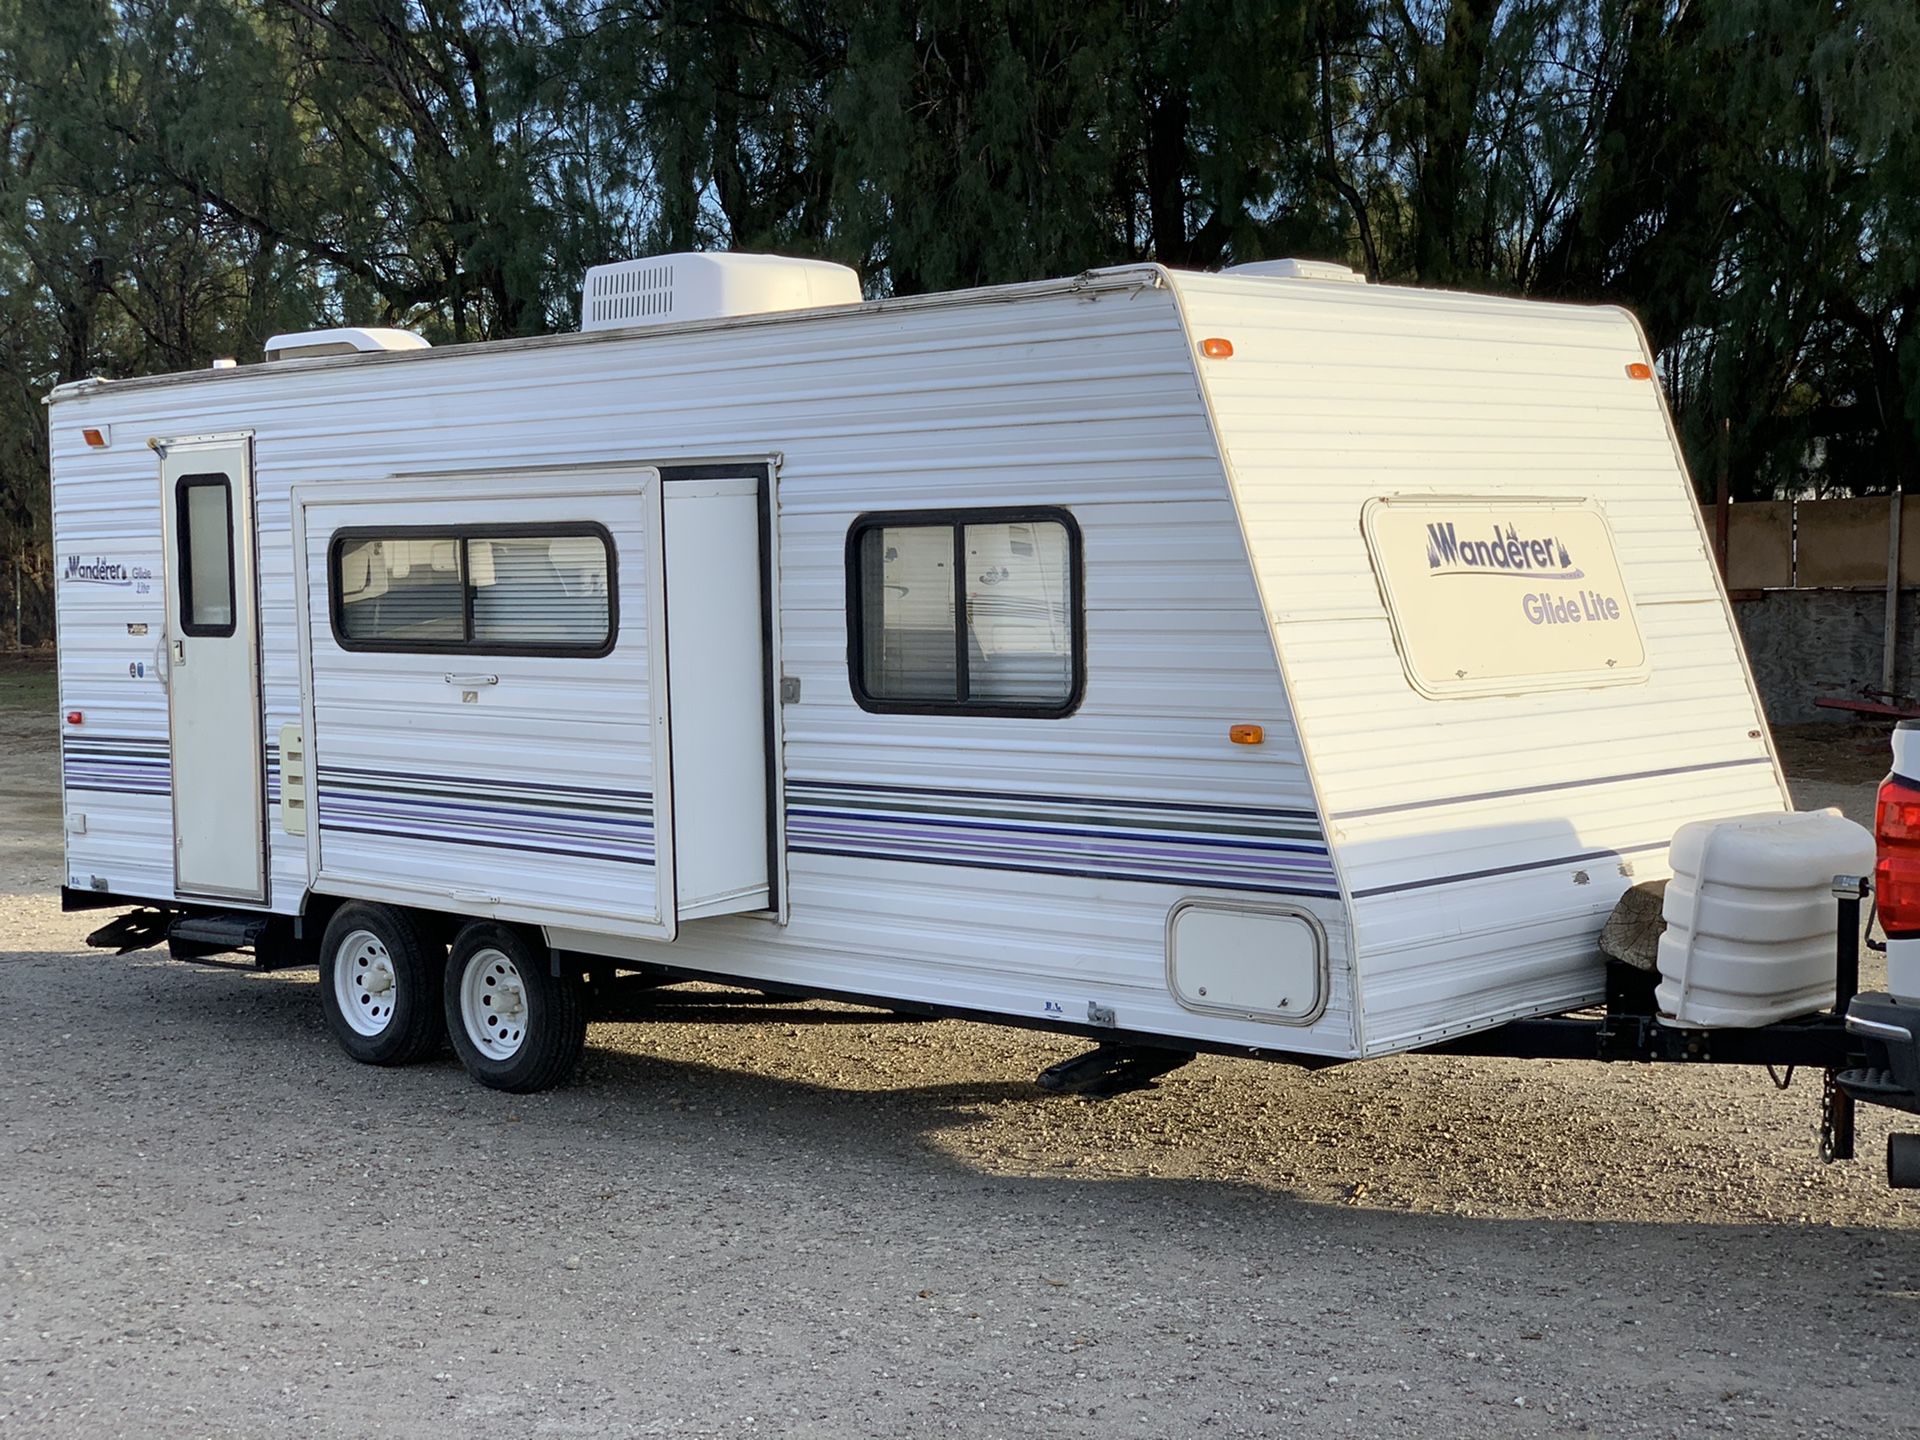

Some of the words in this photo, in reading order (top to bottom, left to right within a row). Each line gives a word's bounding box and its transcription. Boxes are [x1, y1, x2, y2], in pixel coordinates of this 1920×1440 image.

[1427, 522, 1556, 570] Wanderer
[68, 555, 122, 580] Wanderer
[132, 567, 152, 579] Glide
[136, 582, 151, 594] Lite
[1522, 592, 1581, 625] Glide
[1579, 590, 1621, 623] Lite
